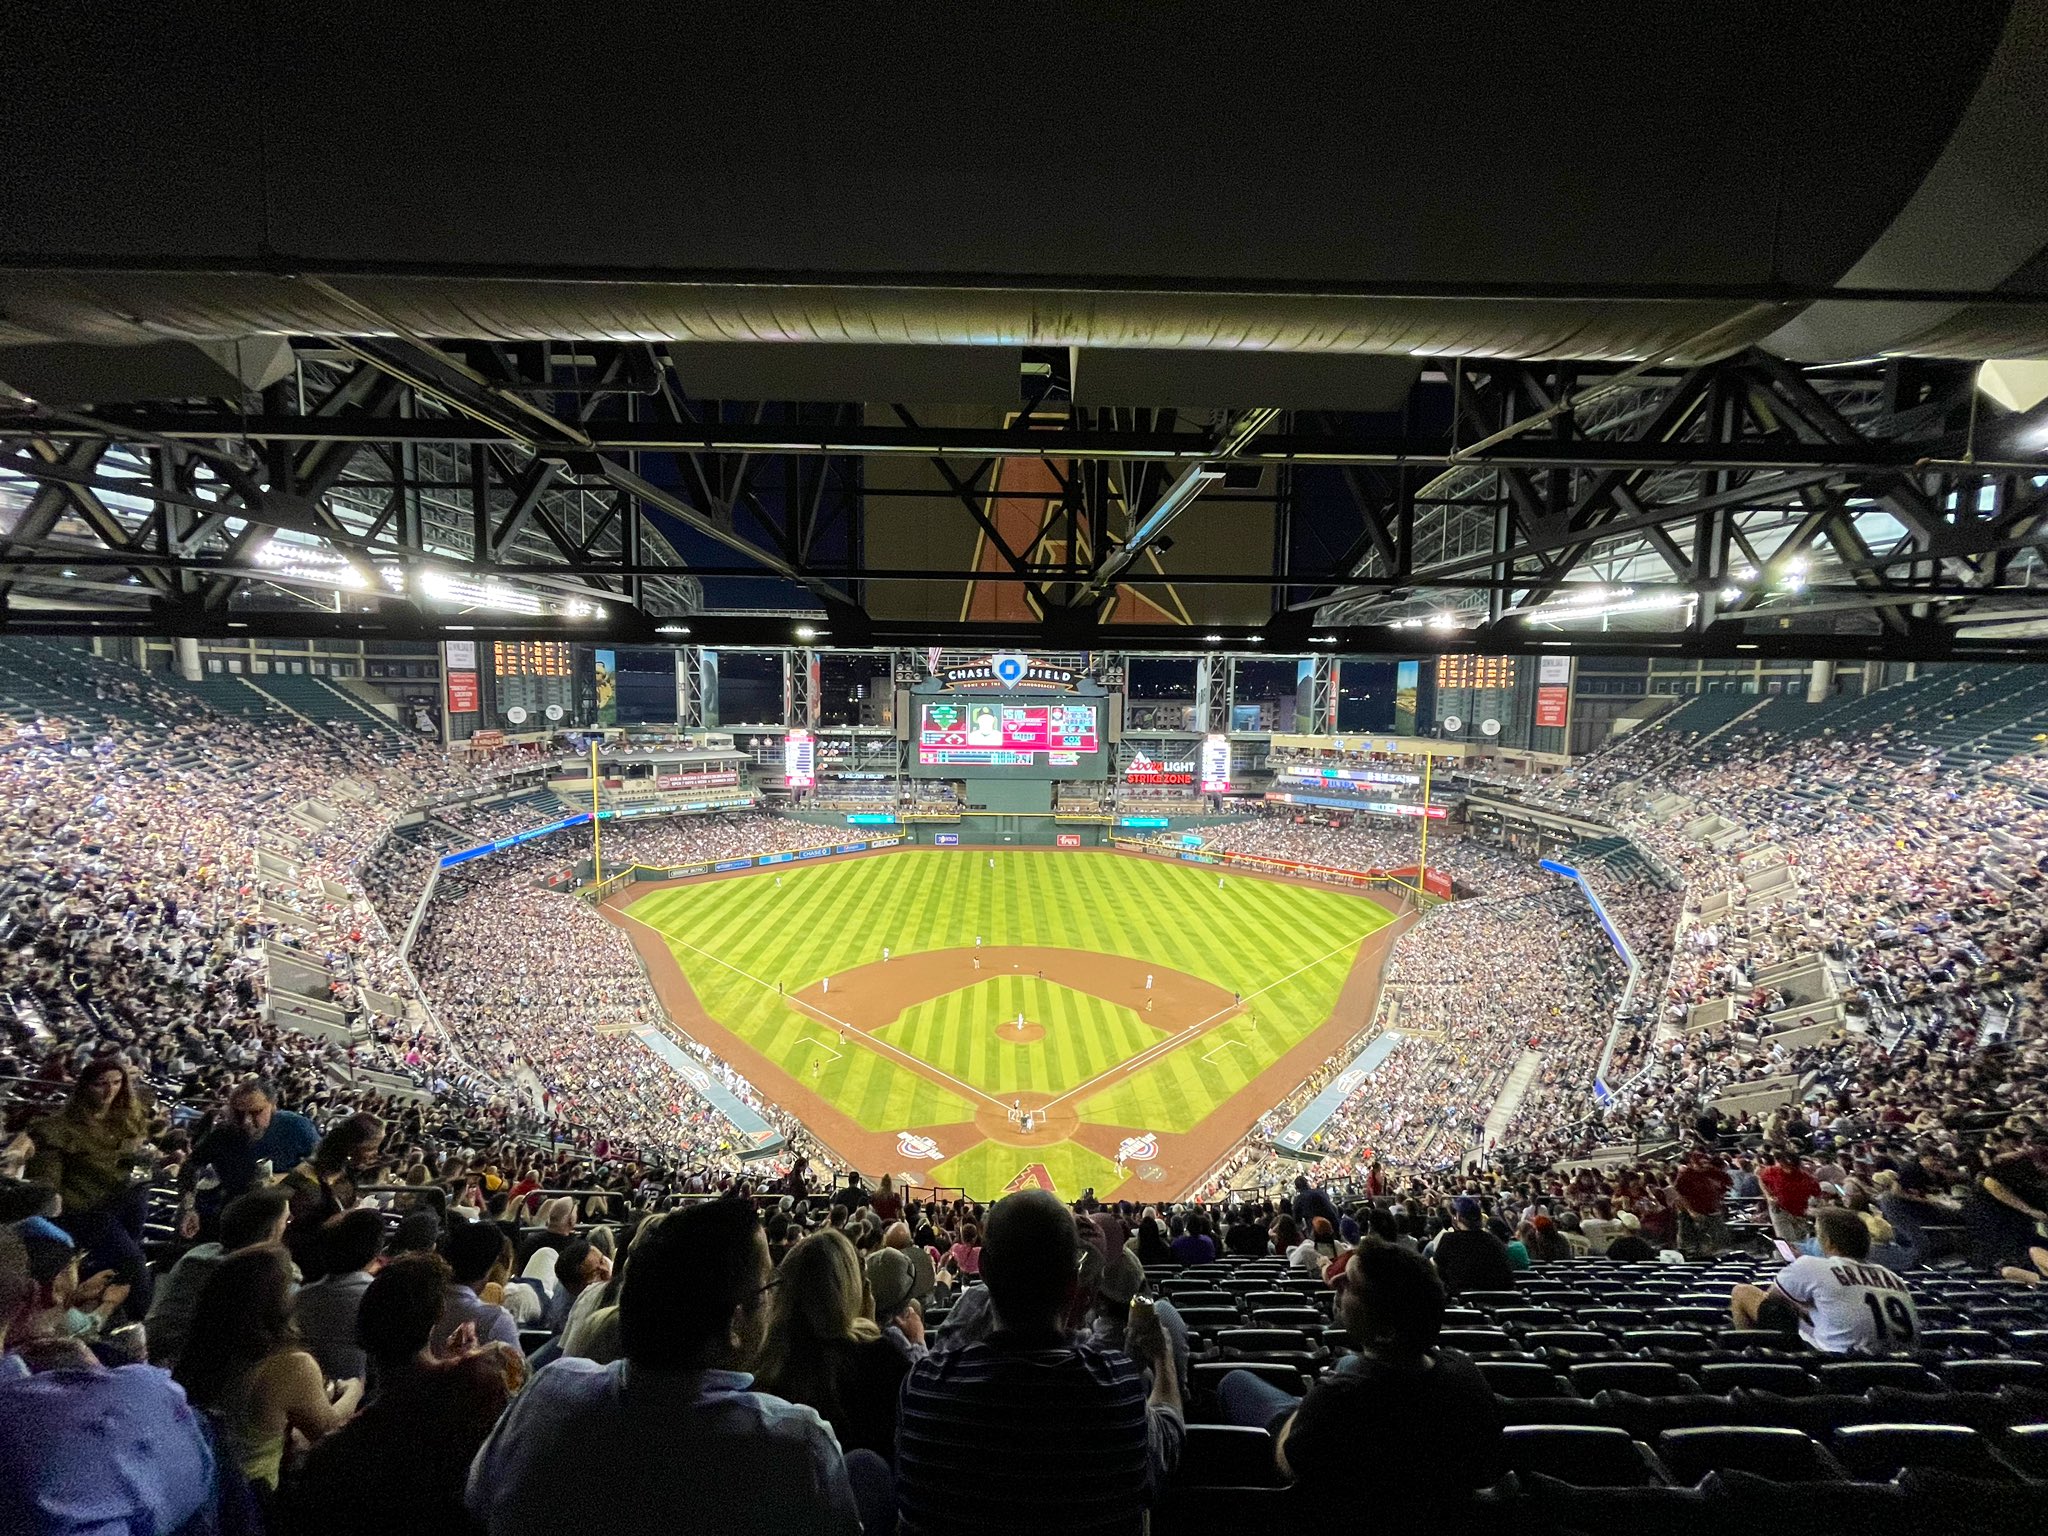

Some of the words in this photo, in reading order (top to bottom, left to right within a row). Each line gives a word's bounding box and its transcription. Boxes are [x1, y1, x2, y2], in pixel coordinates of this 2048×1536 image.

[948, 668, 991, 680] CHASE
[1029, 668, 1071, 681] FIELD
[1163, 762, 1195, 772] LIGHT
[1127, 774, 1163, 784] STRIKE
[1163, 774, 1192, 784] ZONE
[871, 838, 899, 848] GEICO
[803, 849, 821, 857] CHASE
